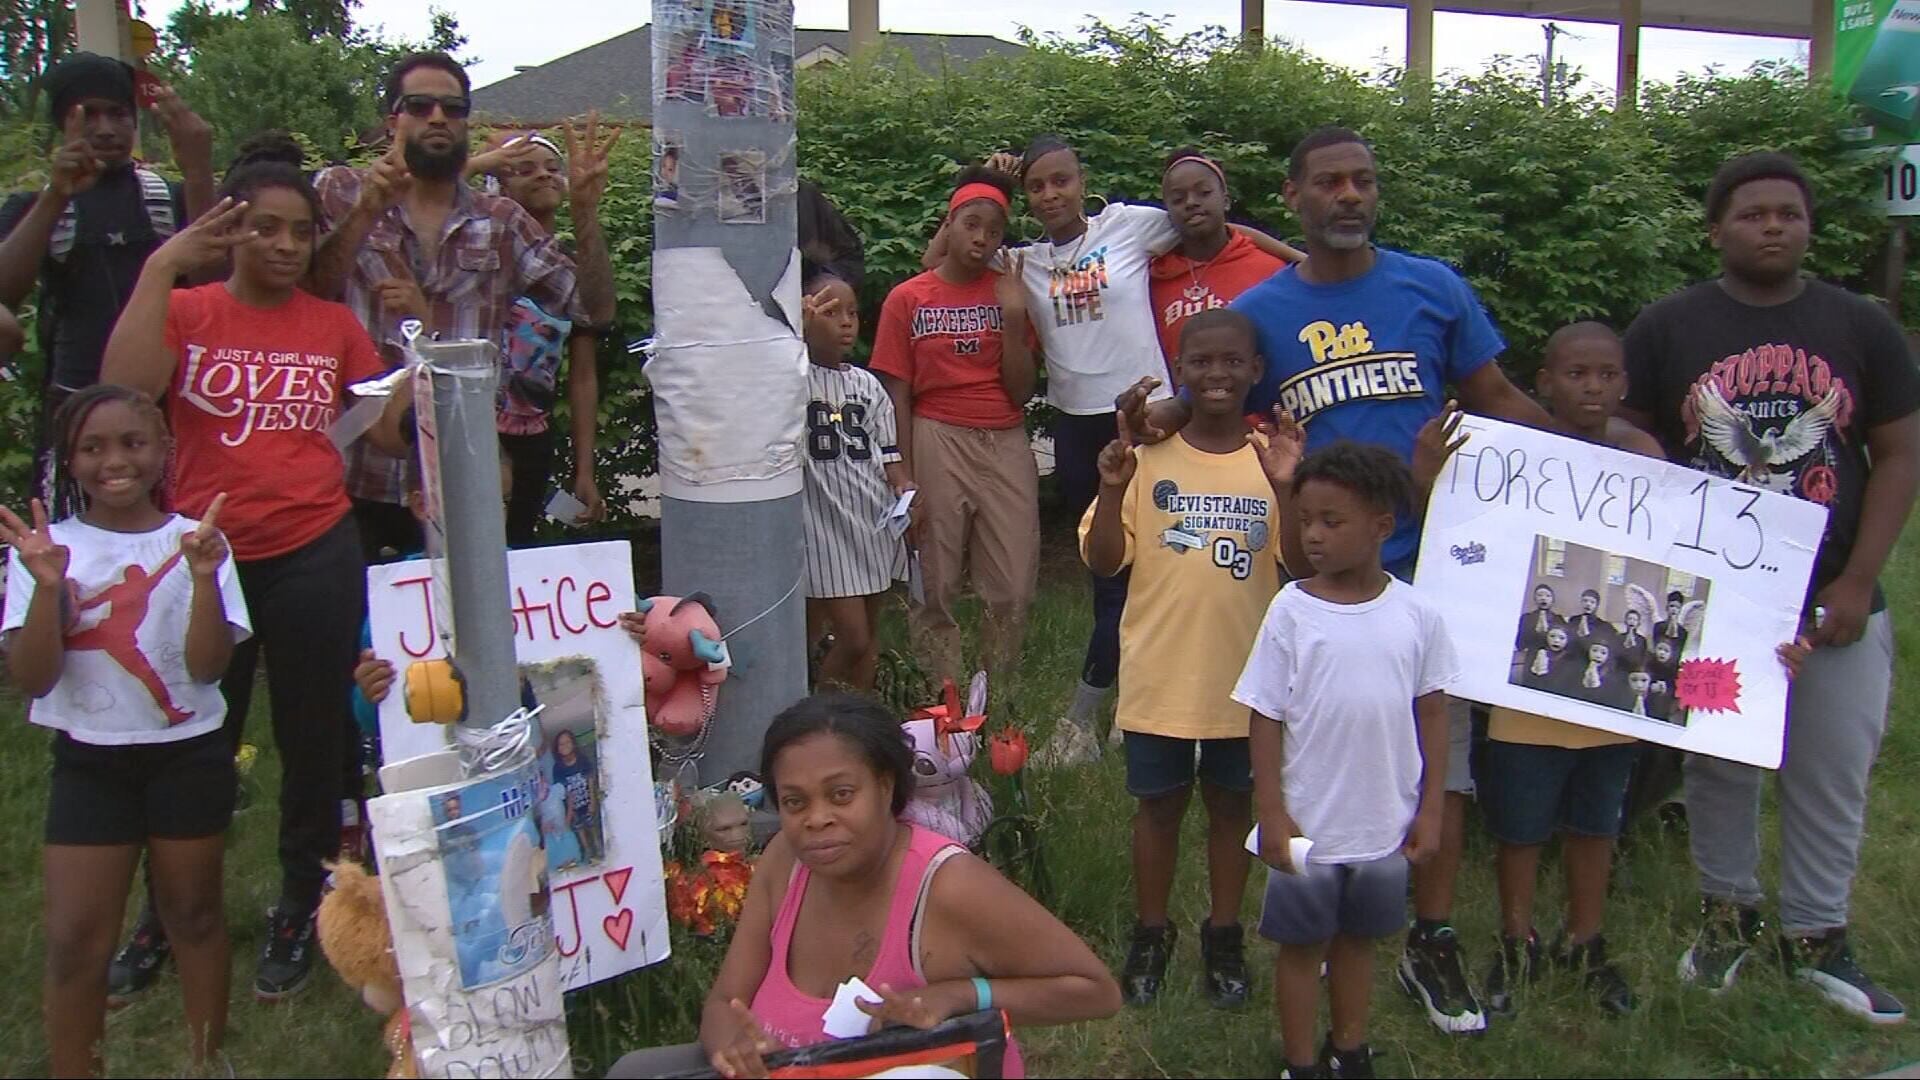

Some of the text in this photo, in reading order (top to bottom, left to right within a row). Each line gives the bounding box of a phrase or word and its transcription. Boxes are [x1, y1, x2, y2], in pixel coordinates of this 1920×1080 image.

[1884, 163, 1917, 201] 10
[1053, 291, 1104, 327] LIFE
[1164, 293, 1232, 327] Duk
[213, 349, 338, 369] JUST A GIRL WHO
[954, 338, 980, 355] M
[1298, 320, 1374, 363] Pitt
[179, 344, 337, 417] LOVES
[1281, 360, 1423, 423] PANTHERS
[220, 402, 335, 446] JESUS
[1450, 424, 1652, 541] FOREVER
[1168, 495, 1200, 514] LEVI
[1203, 495, 1268, 517] STRAUSS
[1184, 516, 1250, 532] SIGNATURE
[1213, 537, 1252, 580] 03
[391, 576, 618, 657] Jtice
